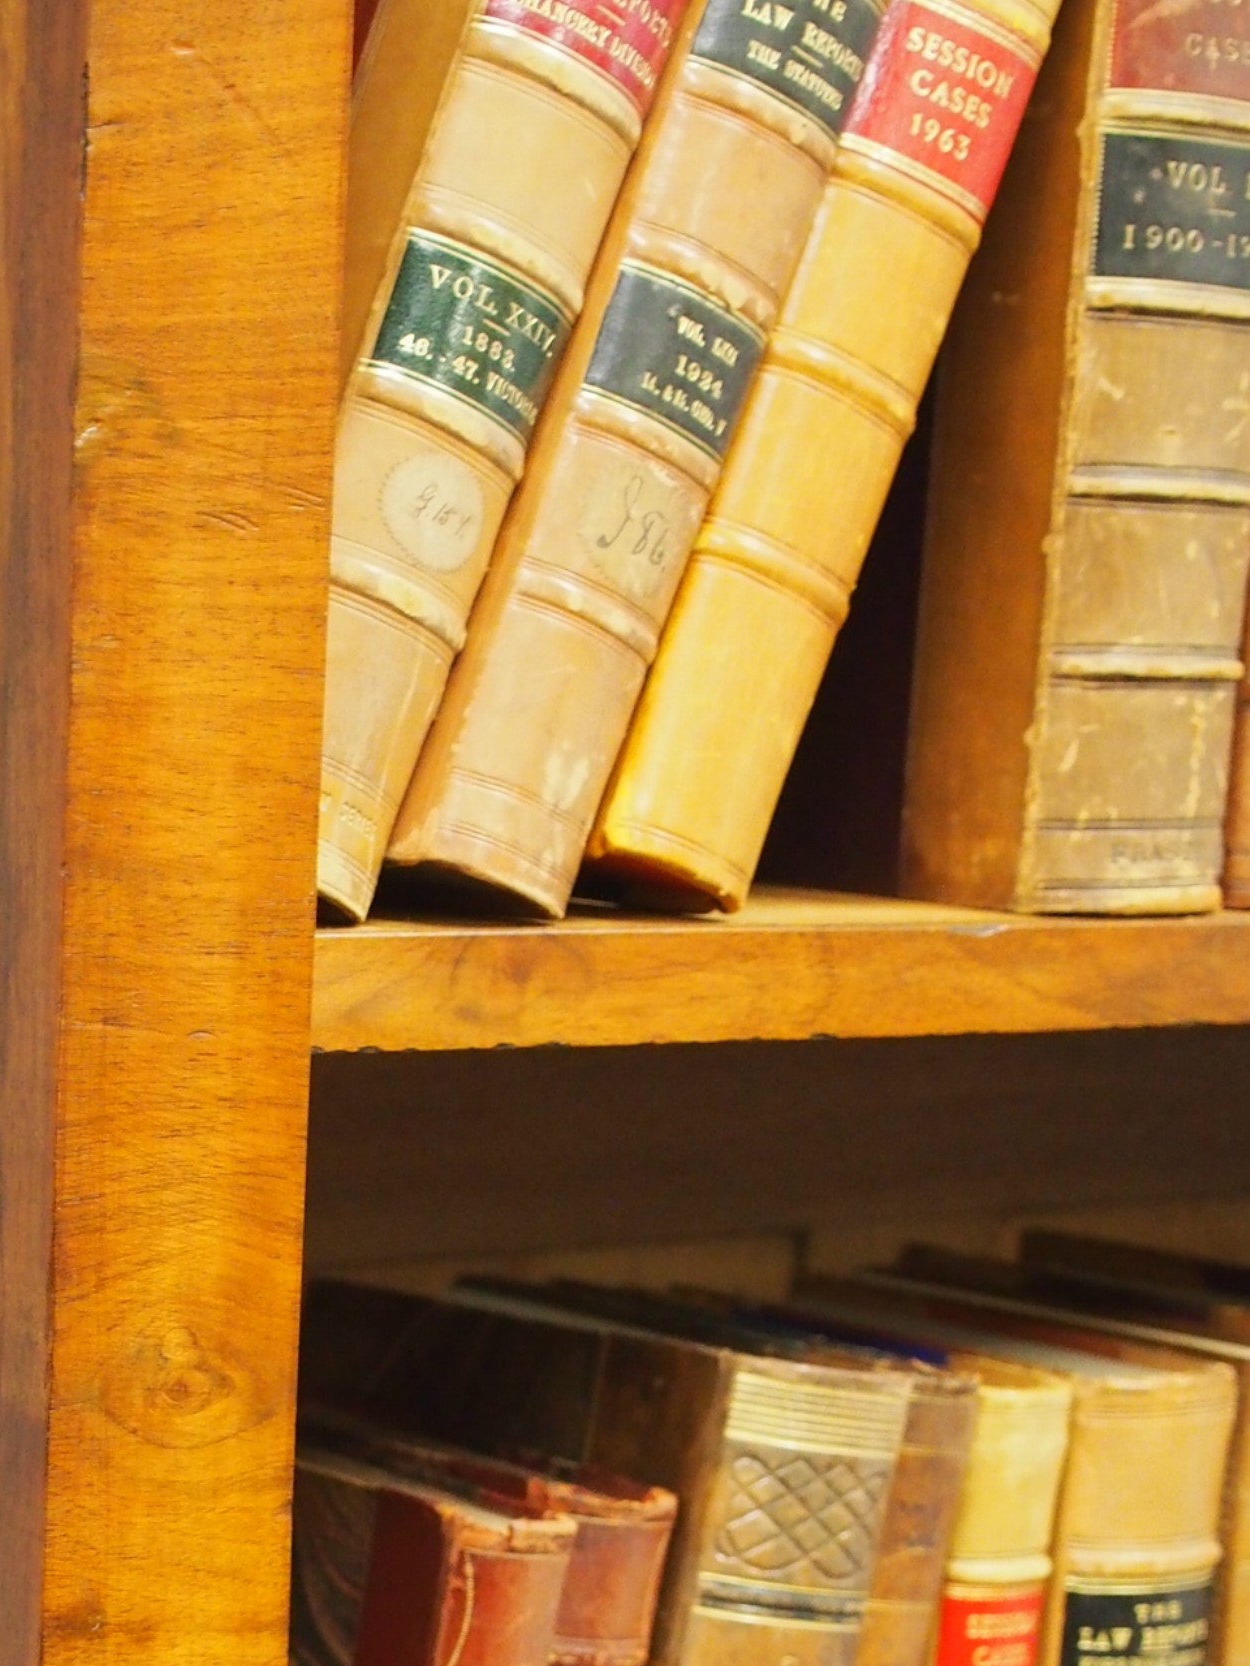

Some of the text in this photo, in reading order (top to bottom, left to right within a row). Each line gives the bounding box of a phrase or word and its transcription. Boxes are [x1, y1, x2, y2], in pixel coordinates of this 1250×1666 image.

[741, 0, 796, 31] LAW
[746, 39, 782, 70] THE
[906, 26, 1015, 99] SESSION
[909, 69, 993, 129] CASES
[910, 112, 972, 162] 1963
[675, 354, 724, 400] 1924
